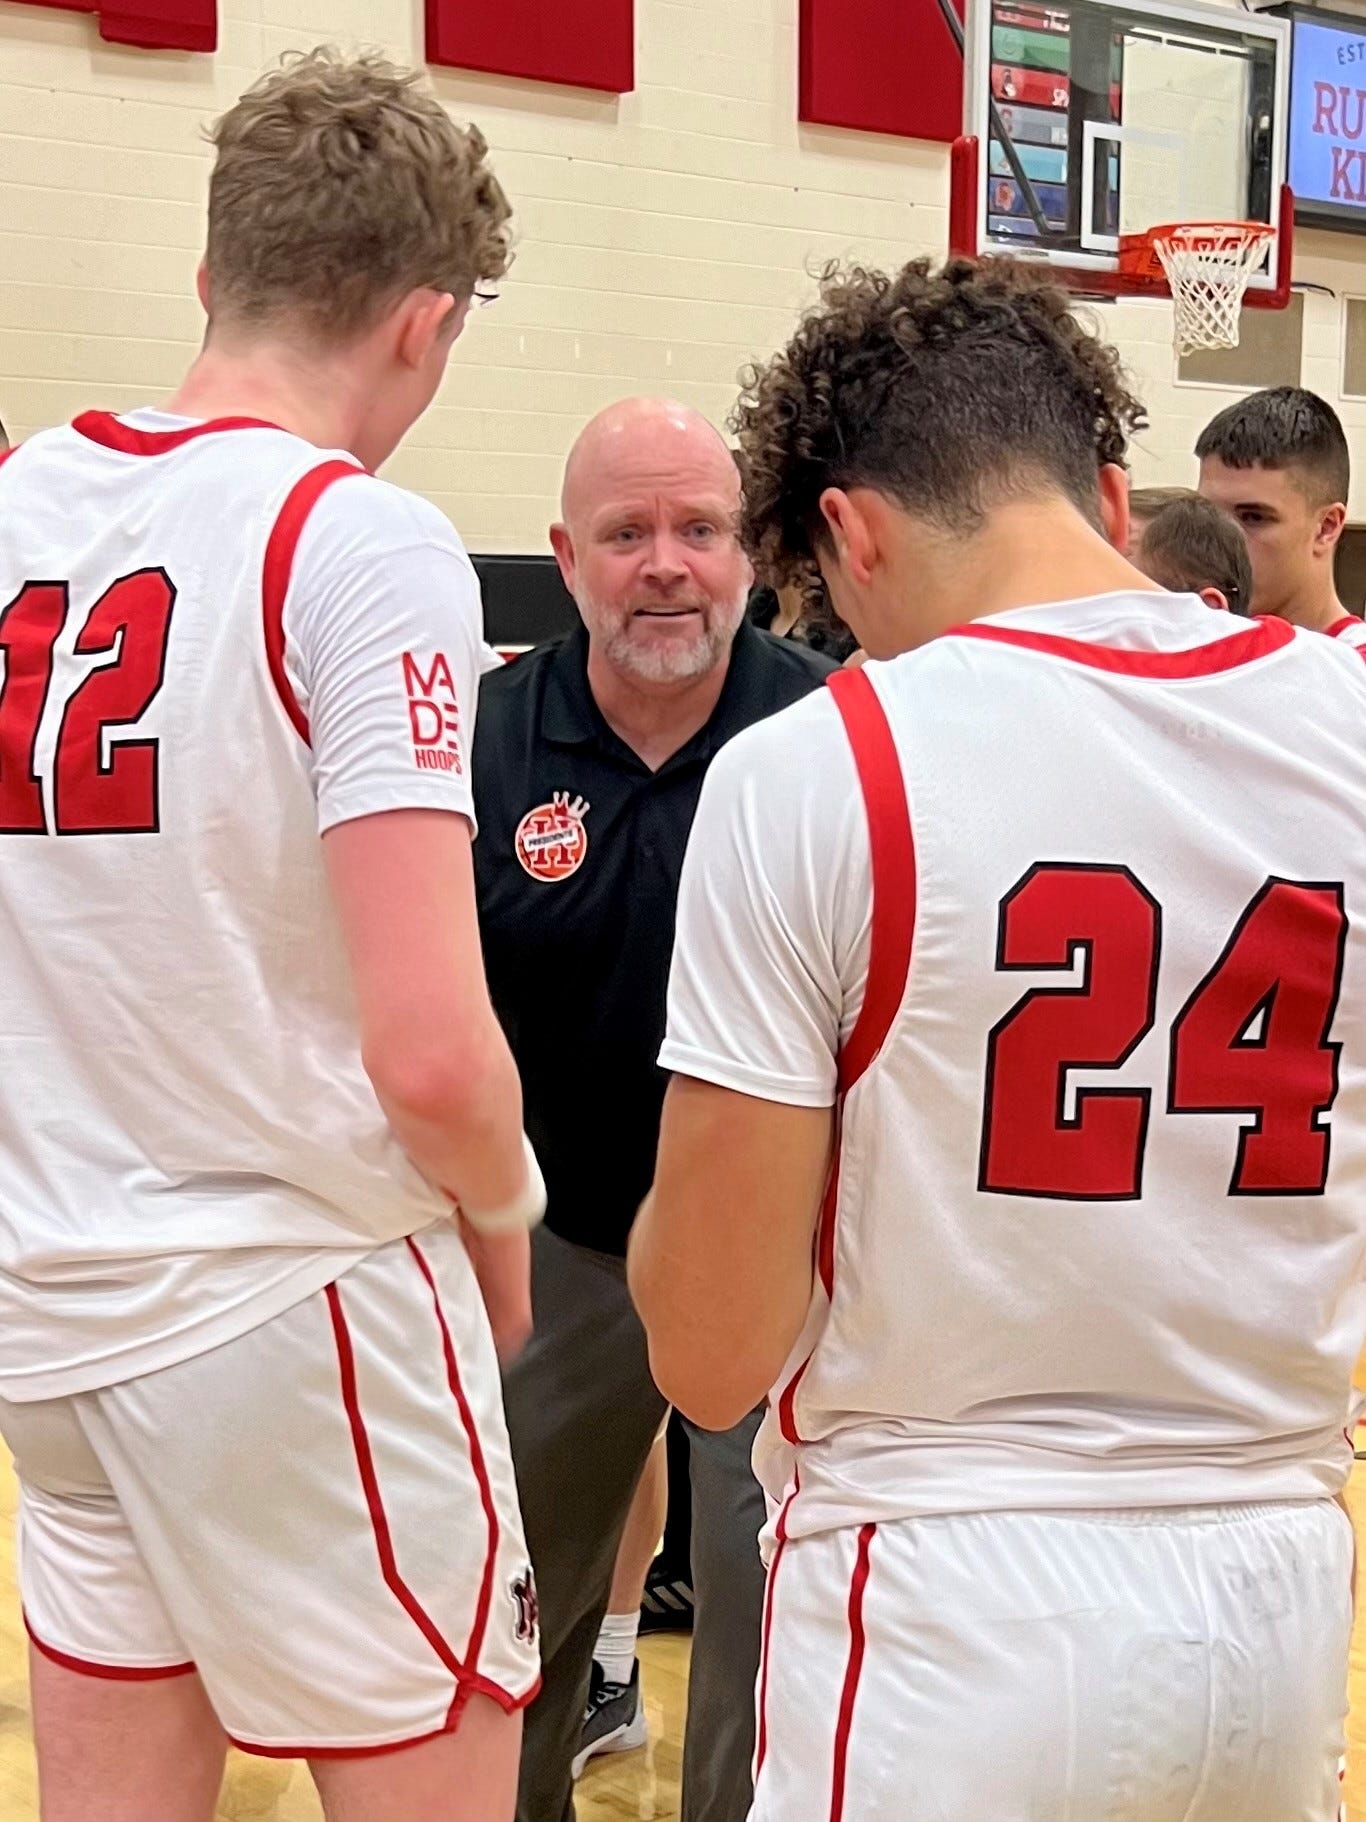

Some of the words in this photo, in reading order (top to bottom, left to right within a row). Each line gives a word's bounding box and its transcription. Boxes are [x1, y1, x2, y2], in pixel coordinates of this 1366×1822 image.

[1312, 81, 1366, 140] RU
[0, 566, 178, 836] 12
[414, 748, 462, 775] HOOPS
[977, 861, 1349, 1201] 24
